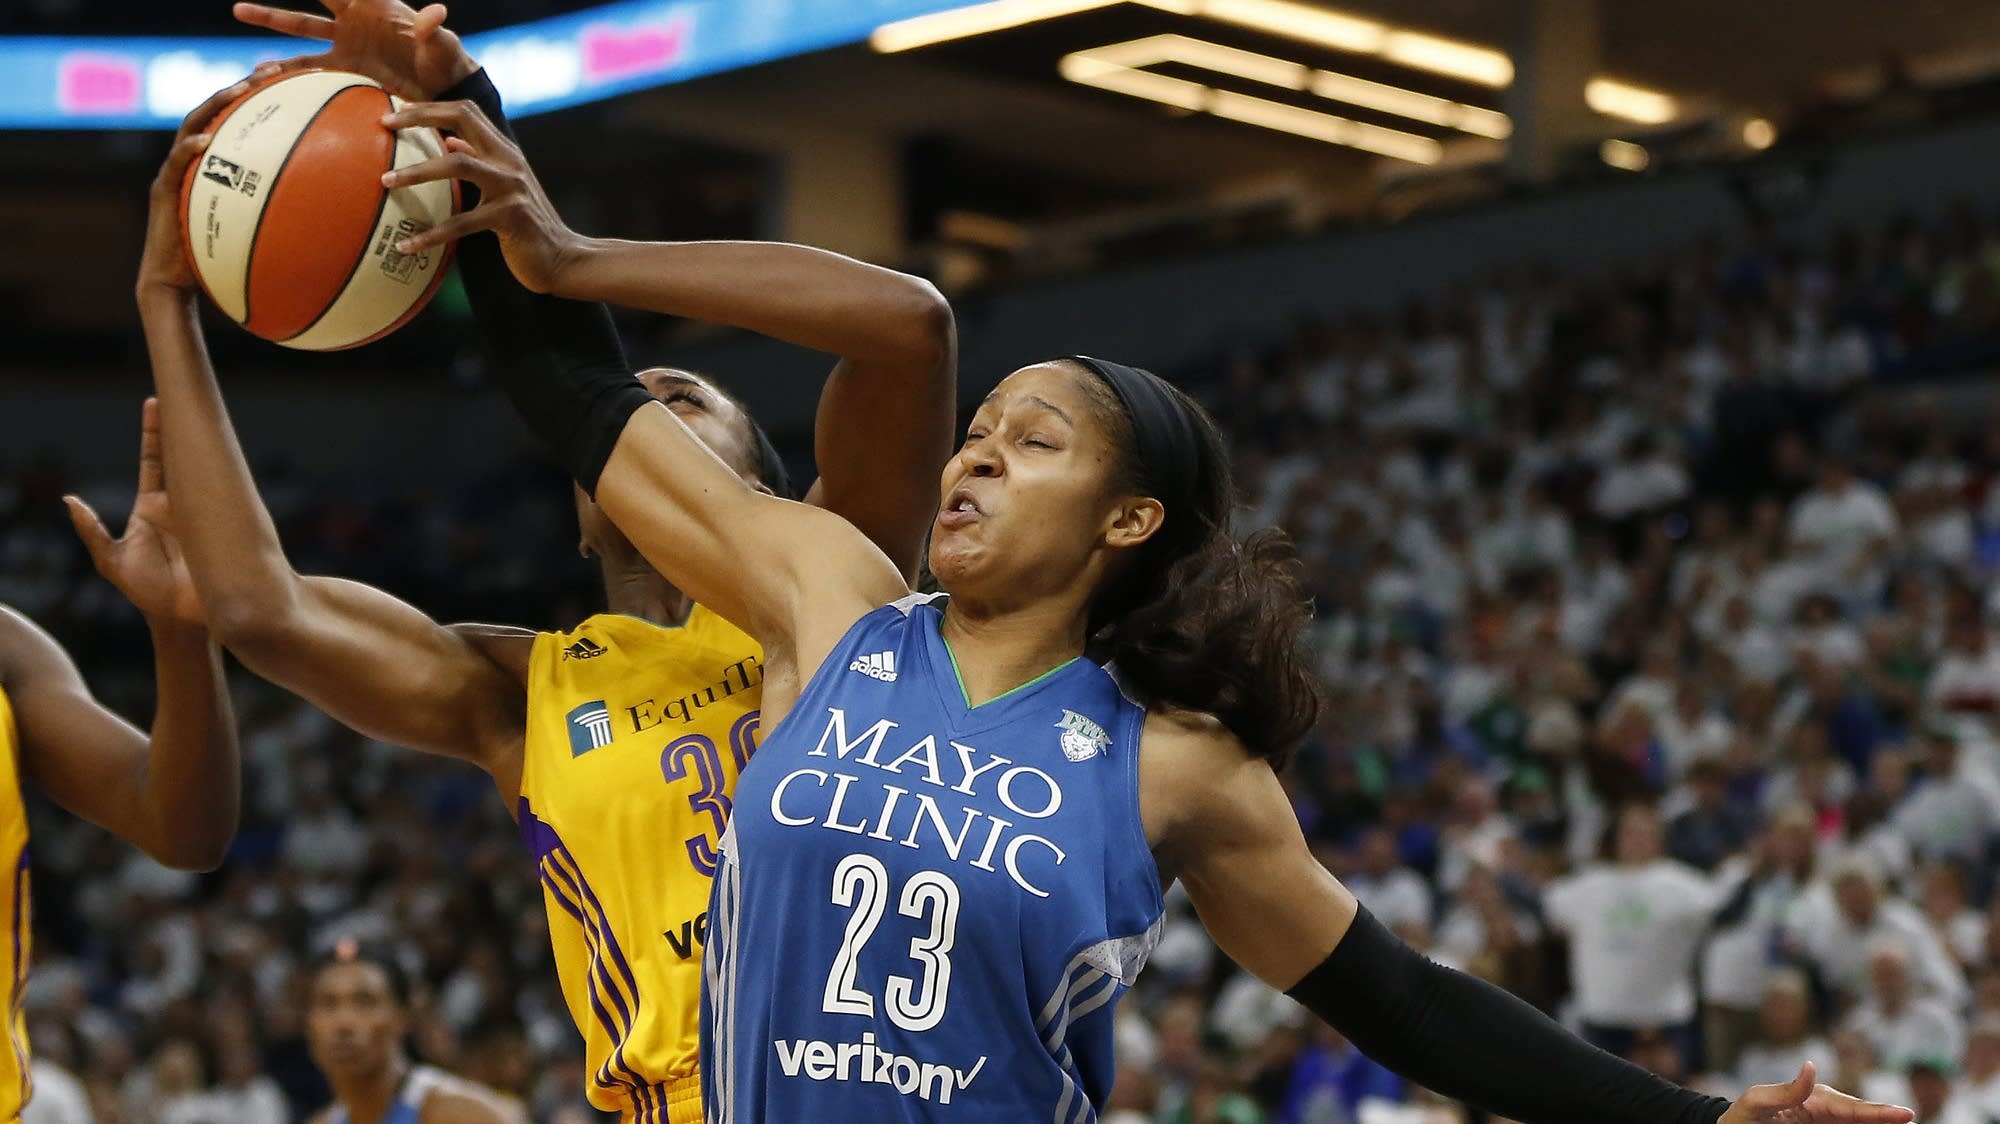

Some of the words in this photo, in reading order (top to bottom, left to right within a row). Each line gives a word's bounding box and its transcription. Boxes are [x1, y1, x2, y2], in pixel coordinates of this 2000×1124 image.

[849, 661, 898, 682] adidas
[807, 707, 1063, 819] MAYO
[770, 769, 1068, 899] CLINIC
[822, 853, 960, 1032] 23
[774, 1032, 956, 1105] verizon
